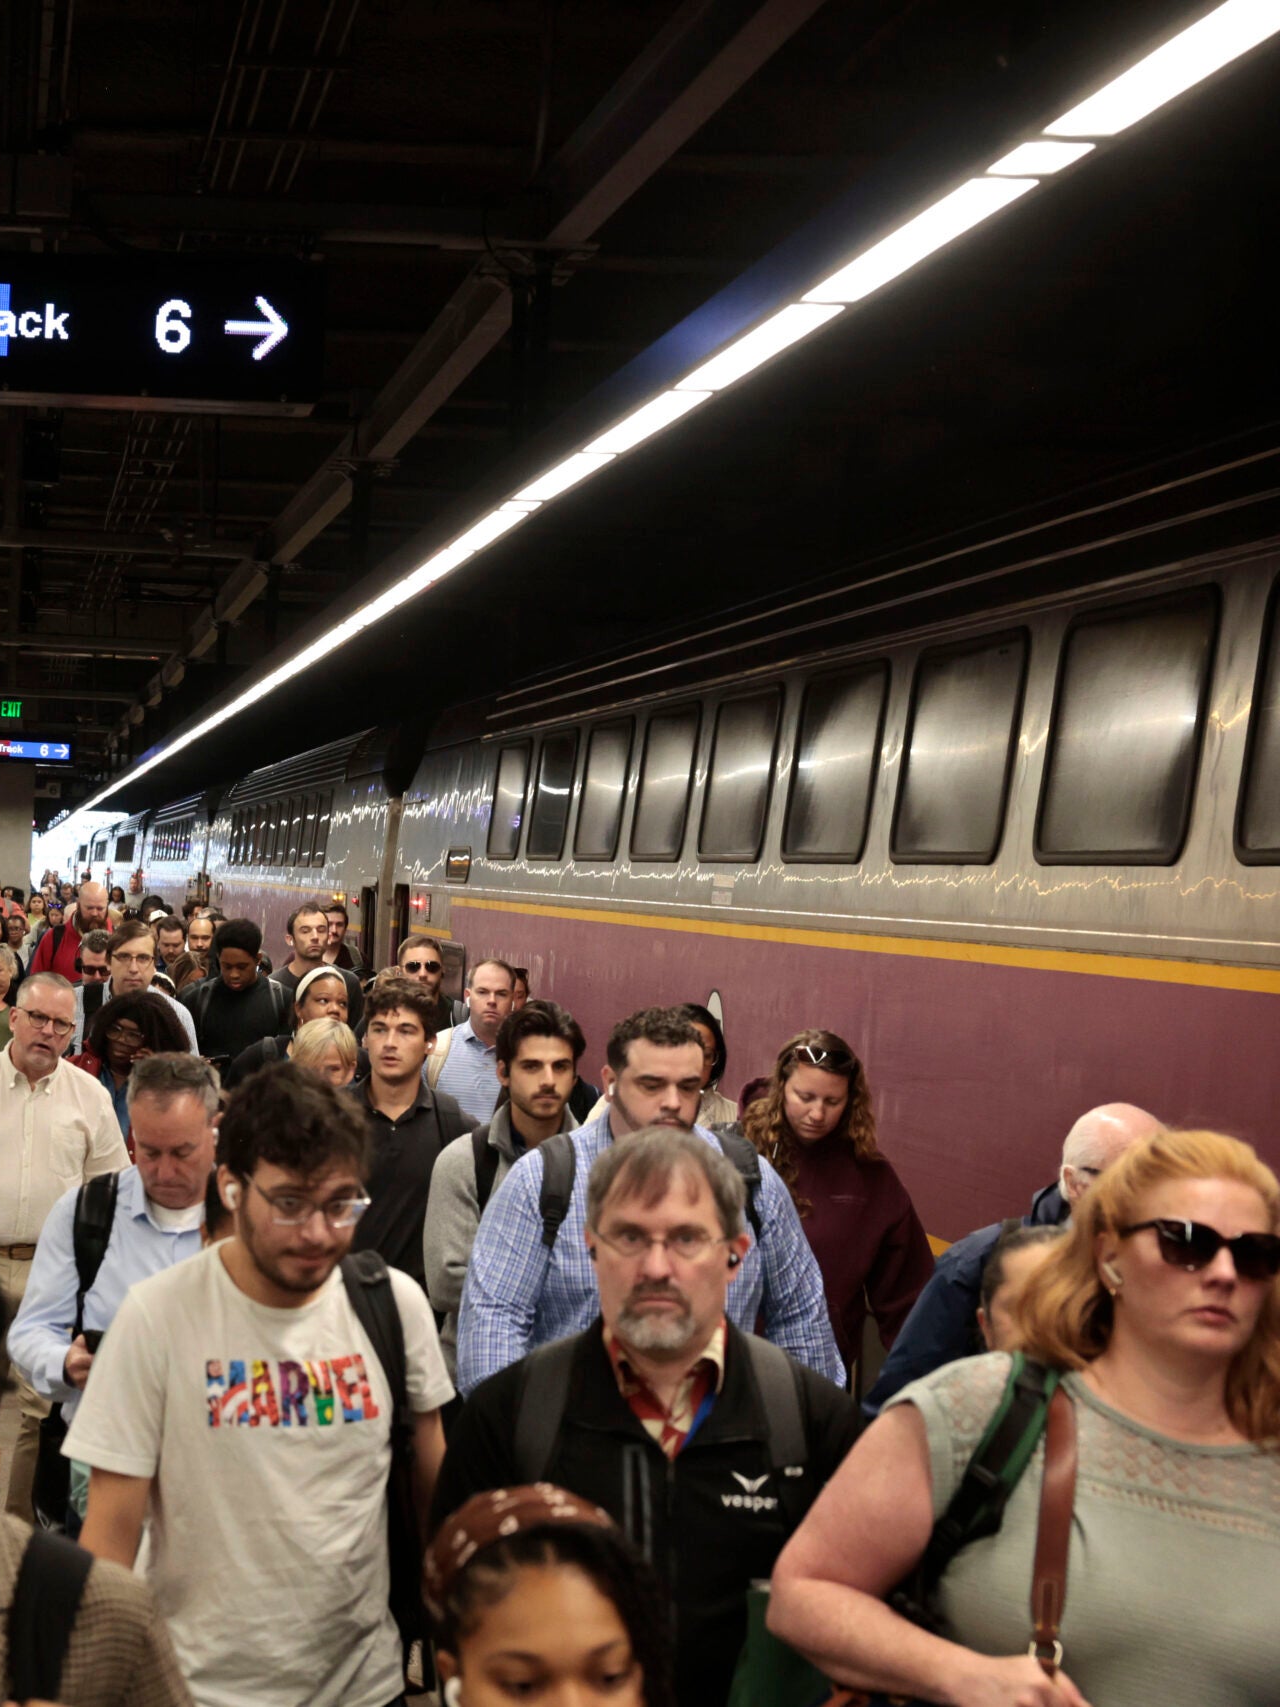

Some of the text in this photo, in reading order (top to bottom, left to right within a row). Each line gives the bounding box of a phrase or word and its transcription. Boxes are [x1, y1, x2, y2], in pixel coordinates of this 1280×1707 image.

[155, 299, 192, 353] 6
[1, 701, 22, 718] EXIT
[40, 744, 49, 757] 6
[206, 1355, 379, 1427] MARVEL
